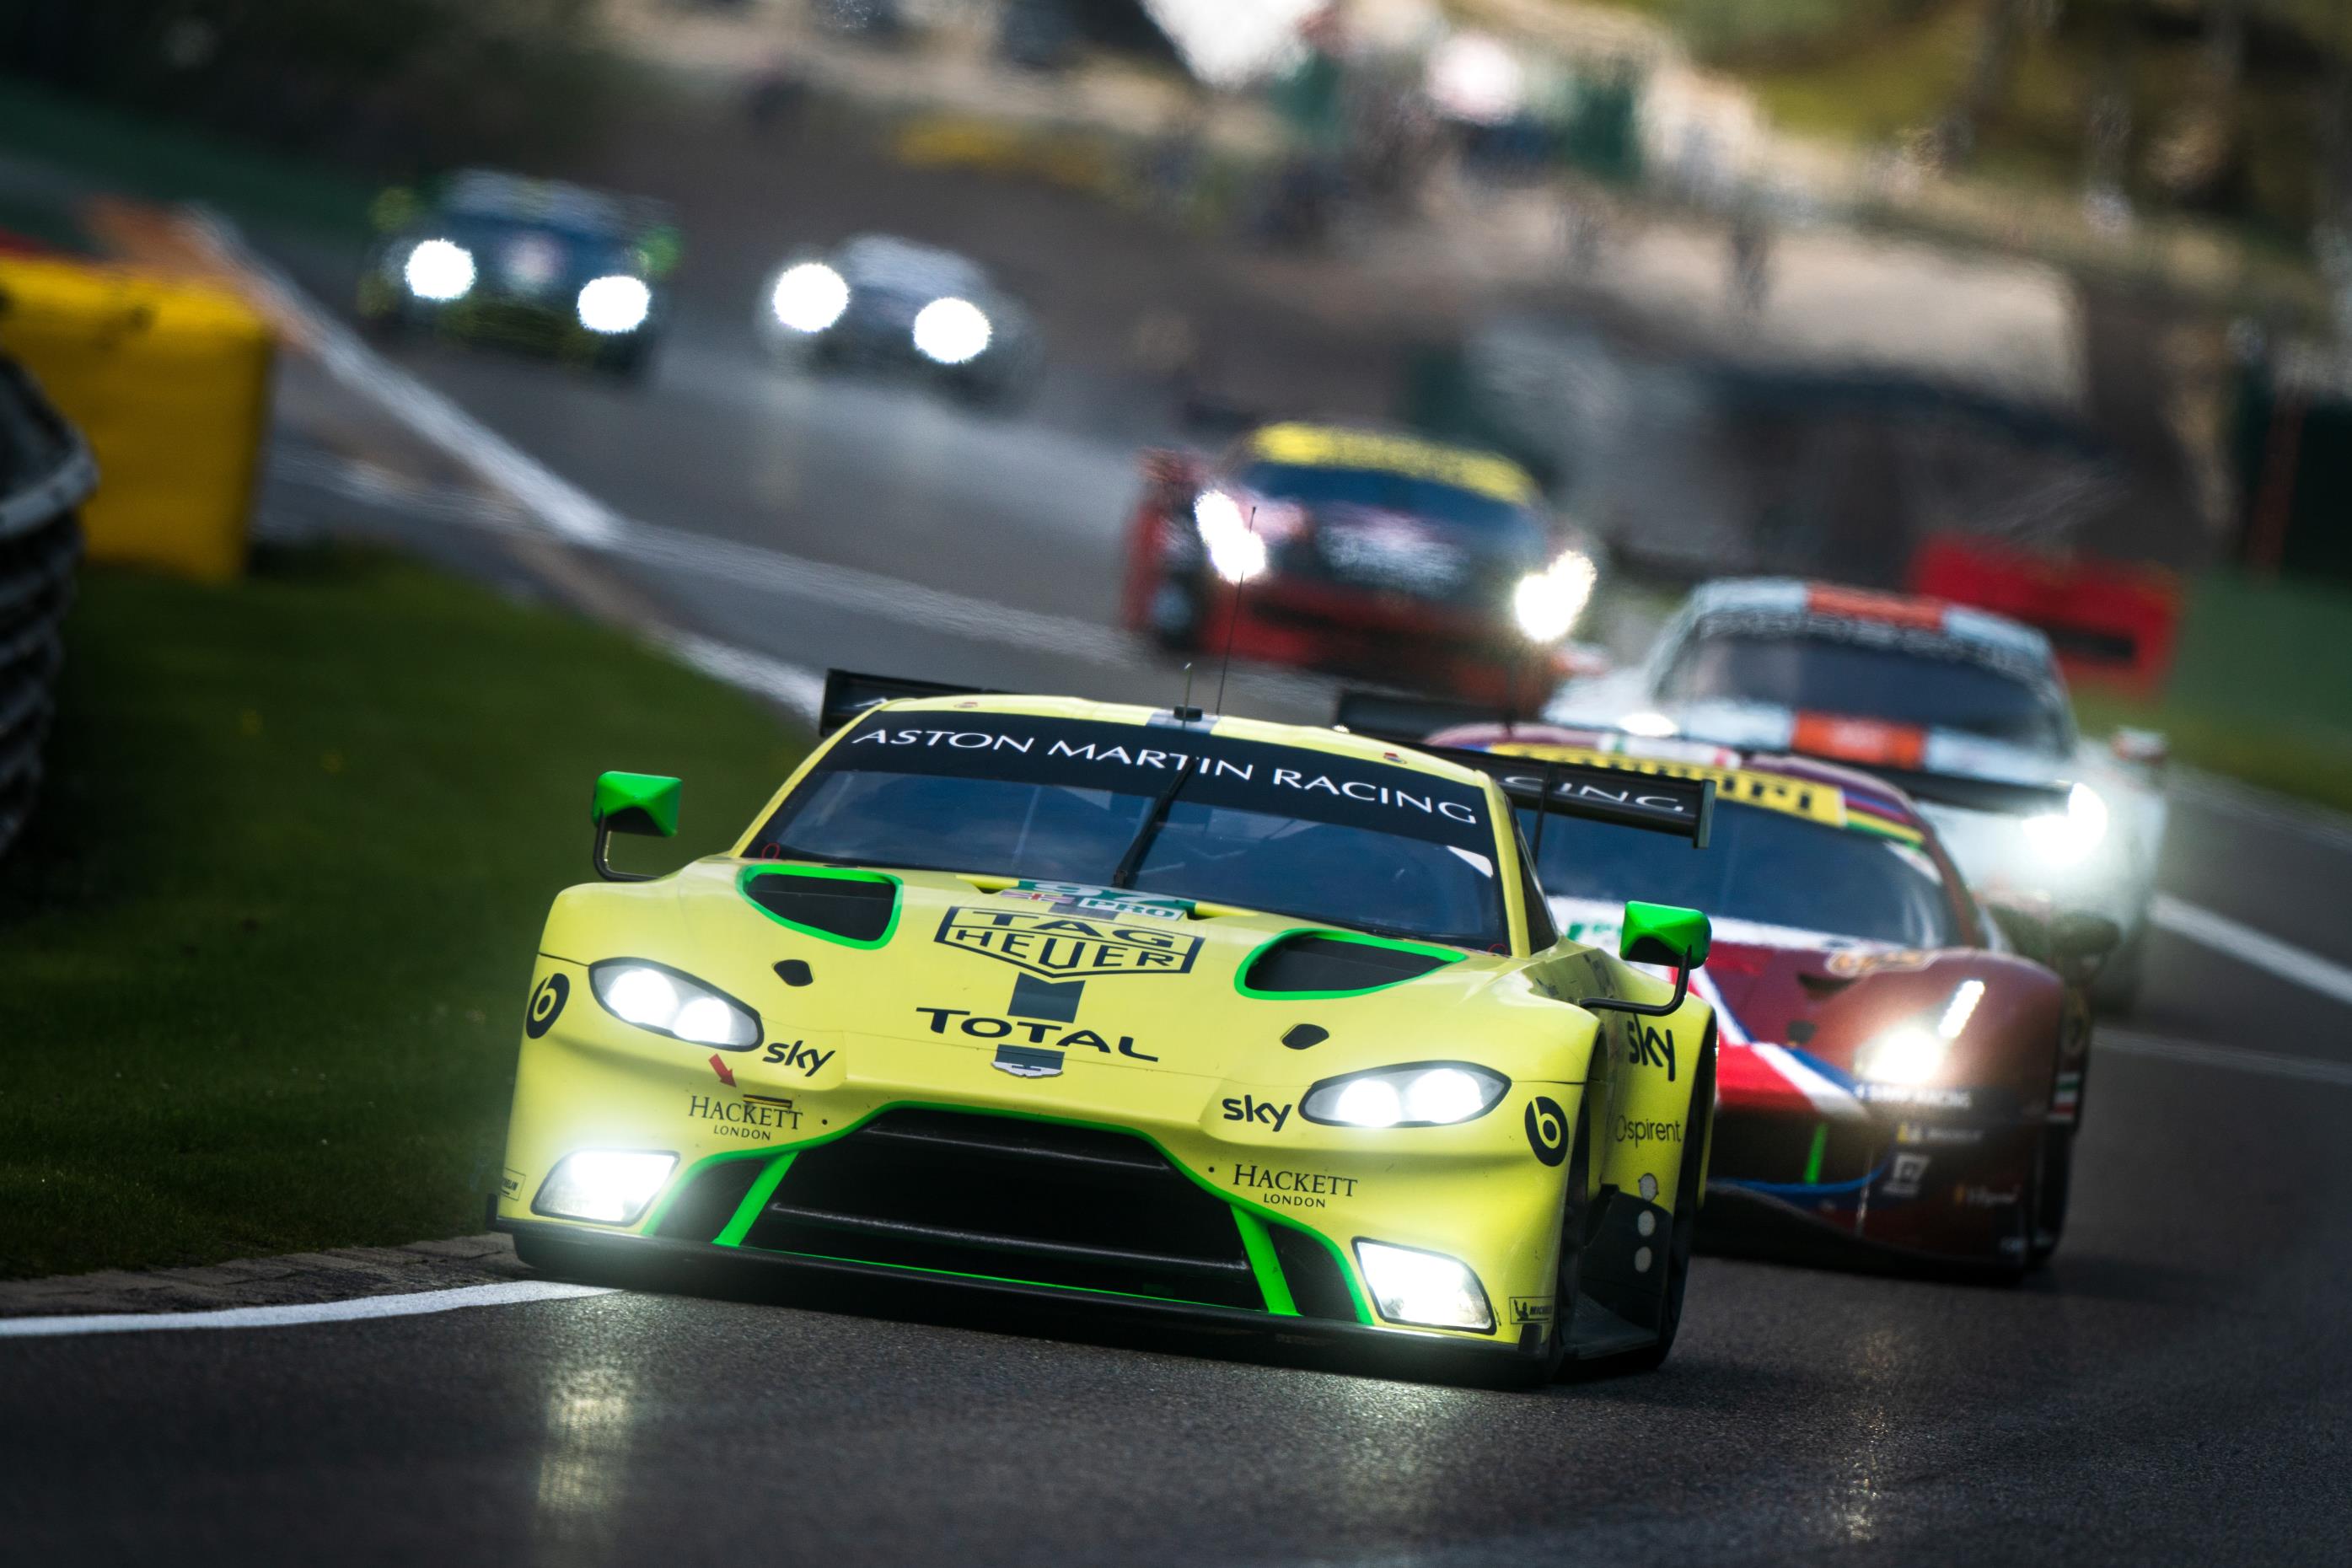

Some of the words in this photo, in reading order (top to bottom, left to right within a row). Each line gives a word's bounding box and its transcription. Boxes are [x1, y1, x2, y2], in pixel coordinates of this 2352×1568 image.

[851, 729, 1035, 754] ASTON
[1047, 739, 1254, 781] MARTIN
[1273, 768, 1477, 824] RACING
[1504, 776, 1685, 814] CING
[1084, 899, 1177, 918] PRO
[972, 910, 1175, 948] TAG
[955, 929, 1175, 969] HEUER
[916, 1007, 1159, 1062] TOTAL
[1627, 1012, 1676, 1082] sky
[762, 1039, 836, 1077] sky
[688, 1095, 803, 1130] HACKETT
[1222, 1094, 1292, 1132] sky
[713, 1124, 771, 1141] LONDON
[1232, 1163, 1359, 1198] HACKETT
[1263, 1193, 1326, 1208] LONDON
